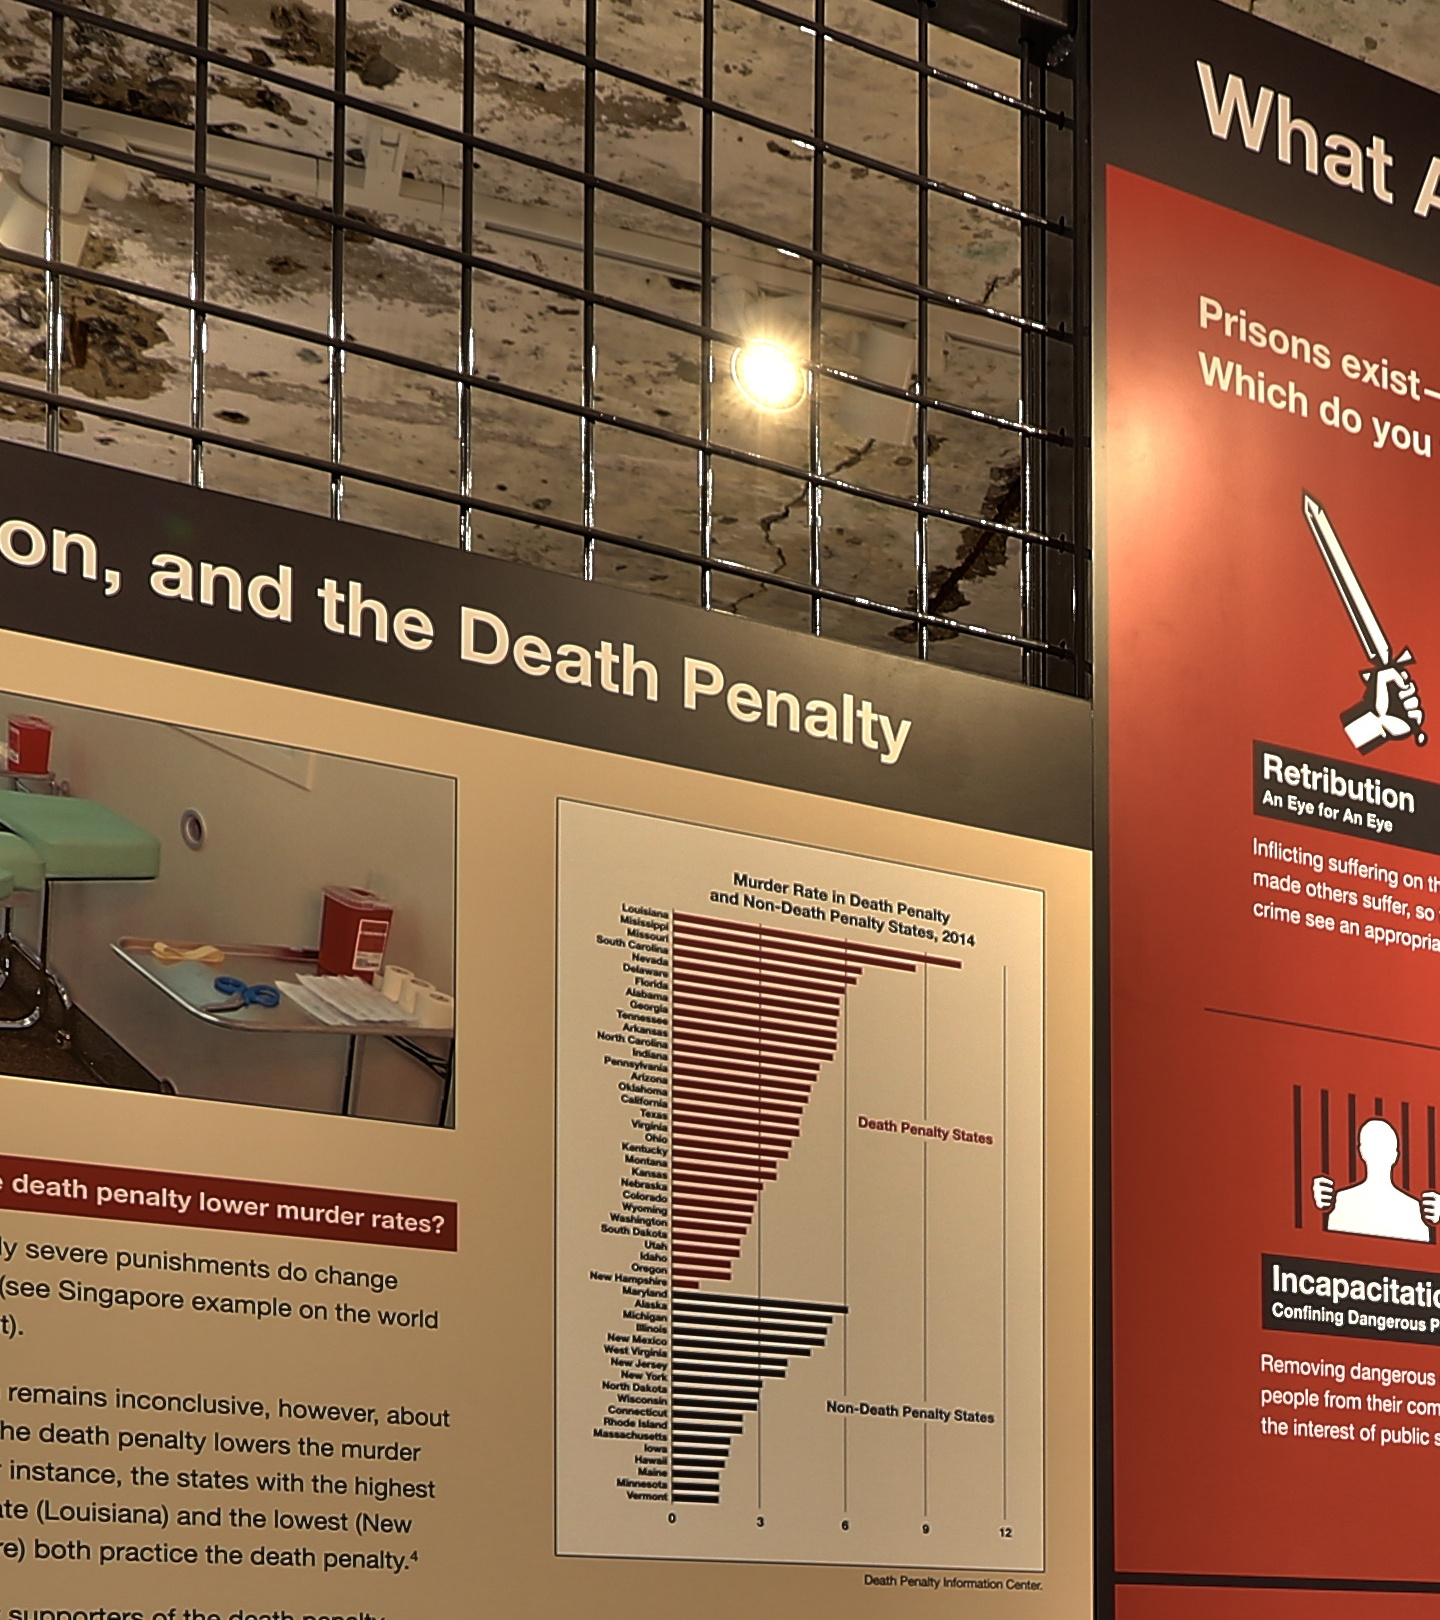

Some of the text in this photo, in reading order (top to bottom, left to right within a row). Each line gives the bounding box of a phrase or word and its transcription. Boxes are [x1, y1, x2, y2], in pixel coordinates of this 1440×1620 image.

[1197, 61, 1392, 203] What
[1200, 297, 1330, 369] Prisons
[151, 554, 291, 622] and
[318, 578, 433, 650] the
[461, 606, 657, 701] Death
[684, 657, 911, 764] Penalty
[1264, 753, 1414, 813] Retribution
[1263, 792, 1392, 833] An Eye for An Eye
[710, 892, 975, 946] and Non-Death Penalty States, 2014
[734, 872, 950, 925] Murder Rate in Death Penalty
[859, 1116, 993, 1144] Death Penalty States
[13, 1174, 87, 1199] death
[97, 1187, 191, 1213] penalty
[200, 1192, 269, 1216] lower
[277, 1205, 364, 1225] murder
[372, 1213, 444, 1233] rates?
[1272, 1302, 1343, 1326] Confining
[1348, 1310, 1426, 1331] Dangerous
[865, 1574, 1042, 1590] Death Penalty Information Center.
